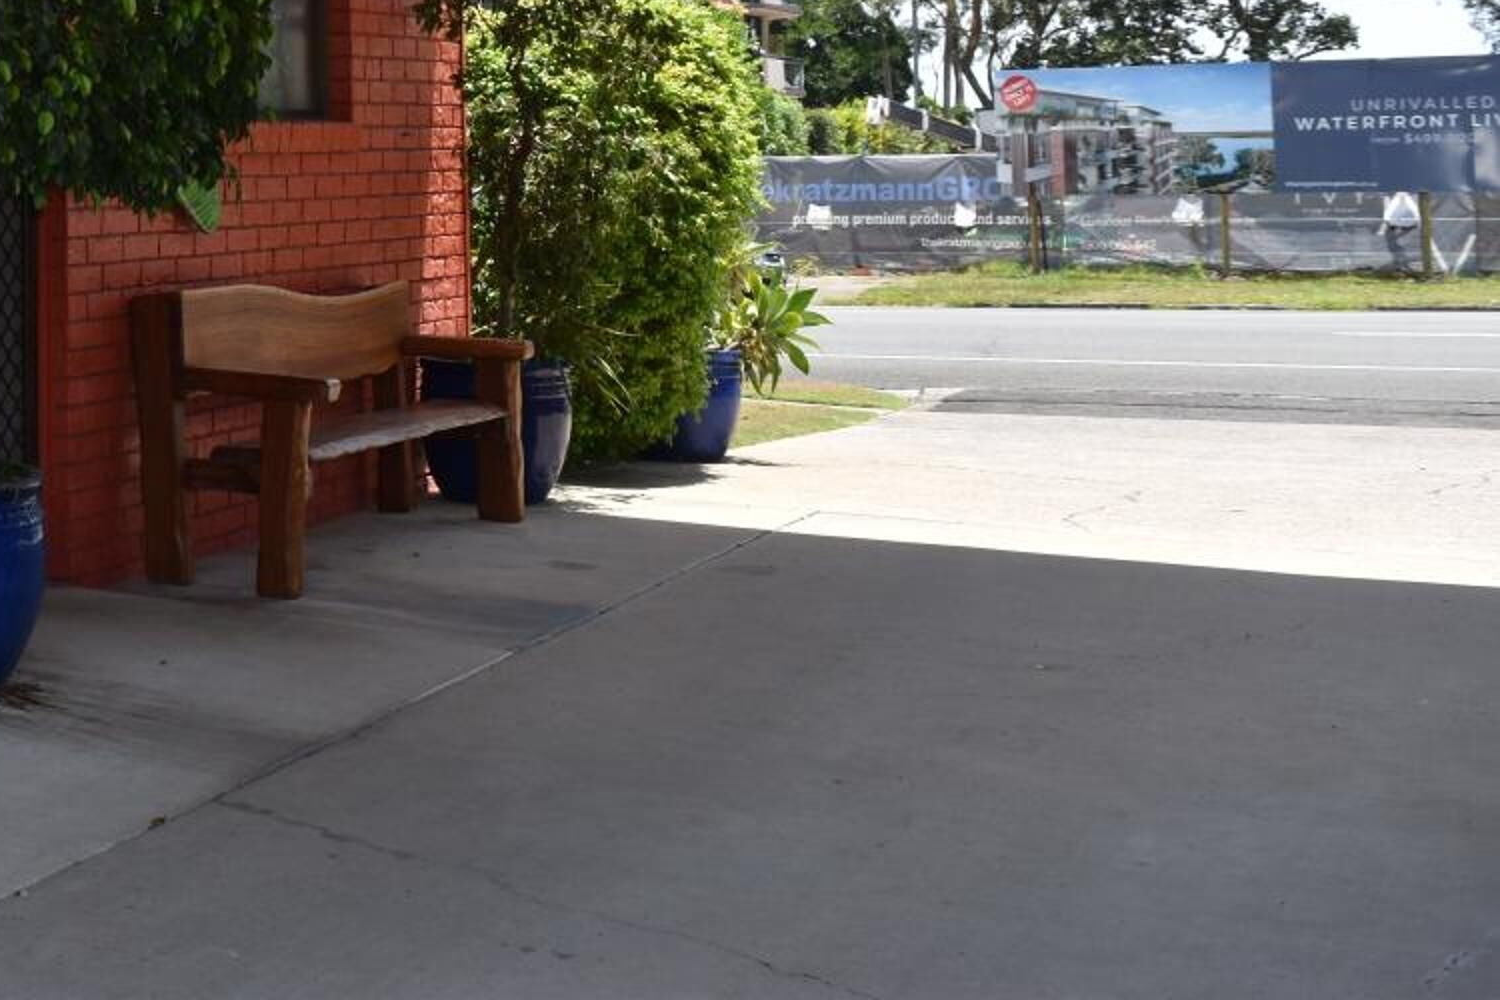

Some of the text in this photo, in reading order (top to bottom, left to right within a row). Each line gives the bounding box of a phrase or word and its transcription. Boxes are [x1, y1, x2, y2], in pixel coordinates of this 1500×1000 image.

[1350, 95, 1496, 112] UNRIVALLED
[1293, 113, 1460, 131] WATERFRONT
[852, 210, 907, 228] premium
[909, 211, 958, 228] produc
[972, 210, 993, 225] nd
